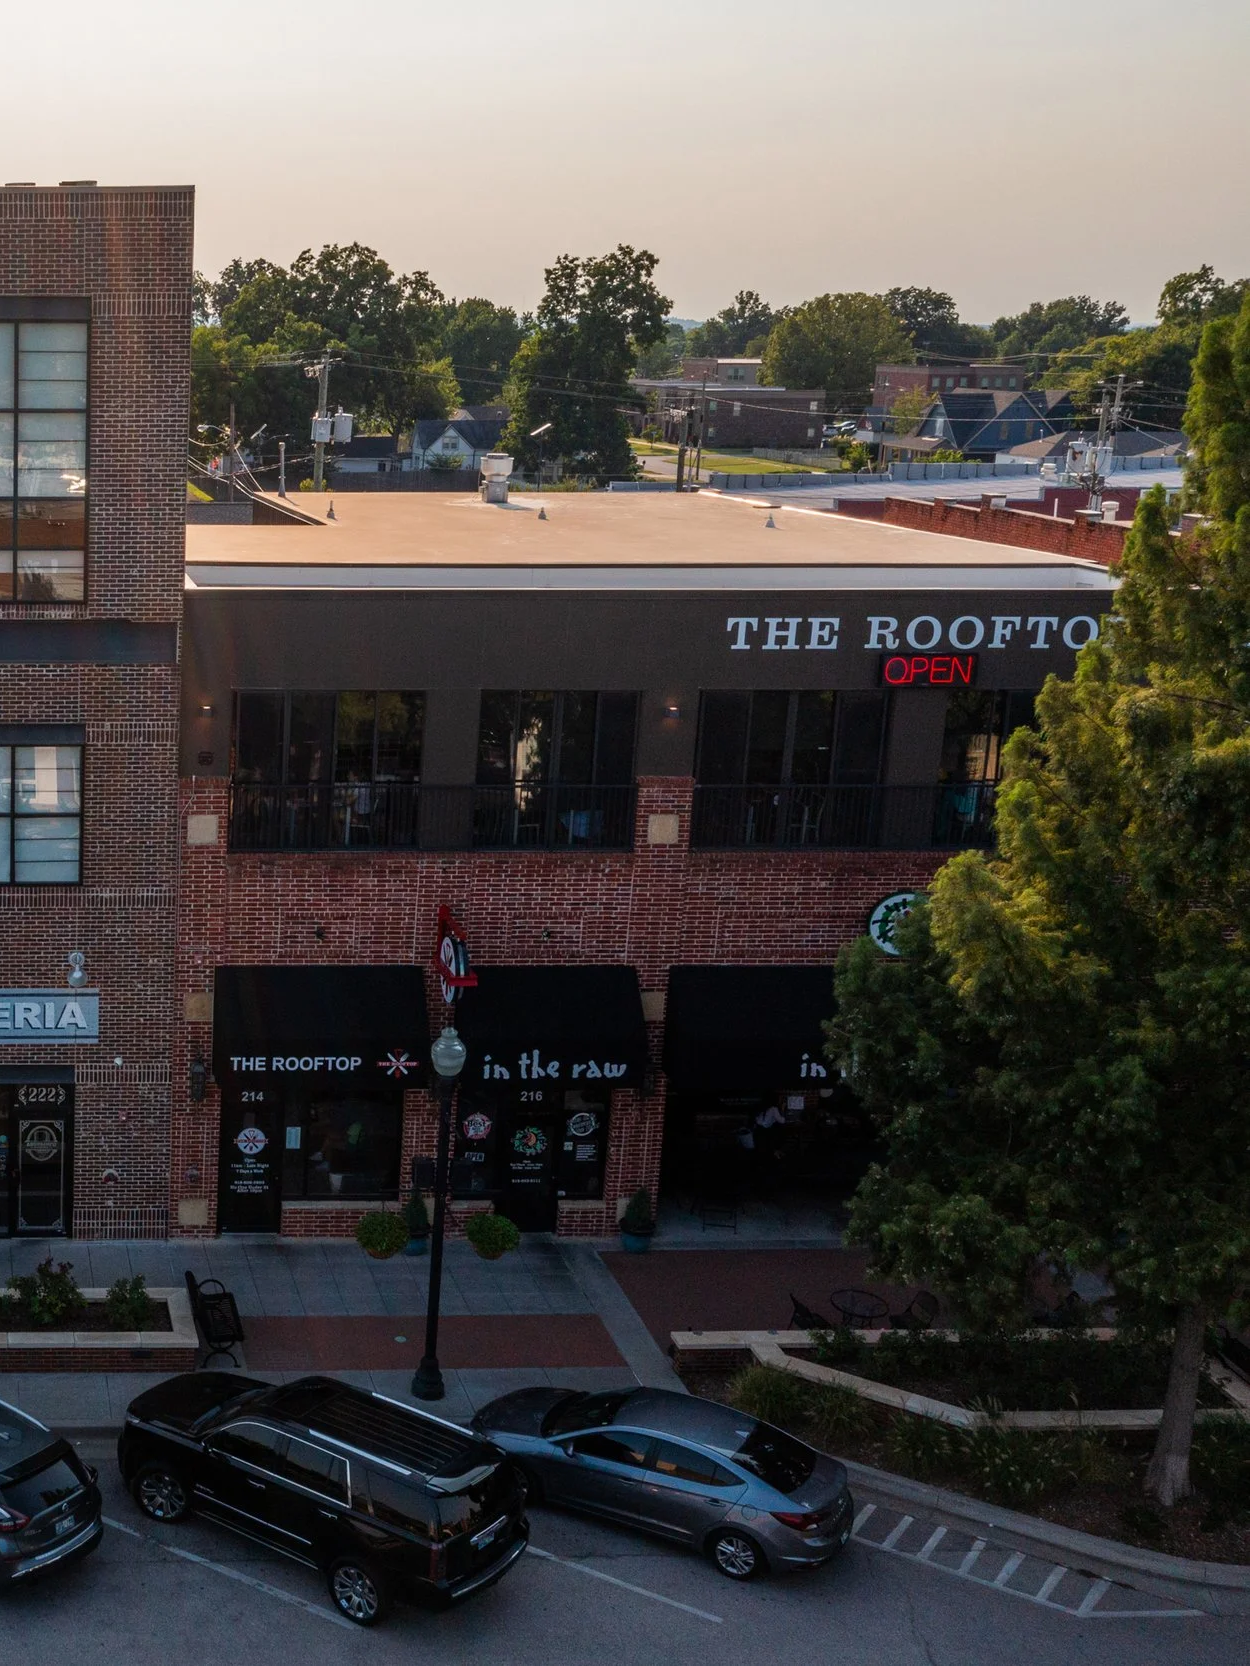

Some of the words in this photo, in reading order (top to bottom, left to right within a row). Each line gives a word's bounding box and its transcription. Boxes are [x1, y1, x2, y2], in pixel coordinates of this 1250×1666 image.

[727, 616, 841, 650] THE
[864, 615, 1125, 650] ROOFTO
[884, 655, 974, 684] OPEN
[230, 1057, 266, 1071] THE
[272, 1057, 362, 1071] ROOFTOP
[483, 1054, 510, 1080] in
[518, 1049, 560, 1080] the
[572, 1060, 627, 1080] raw
[800, 1053, 827, 1078] in
[28, 1087, 56, 1102] 222
[241, 1091, 265, 1102] 214
[520, 1091, 543, 1102] 216
